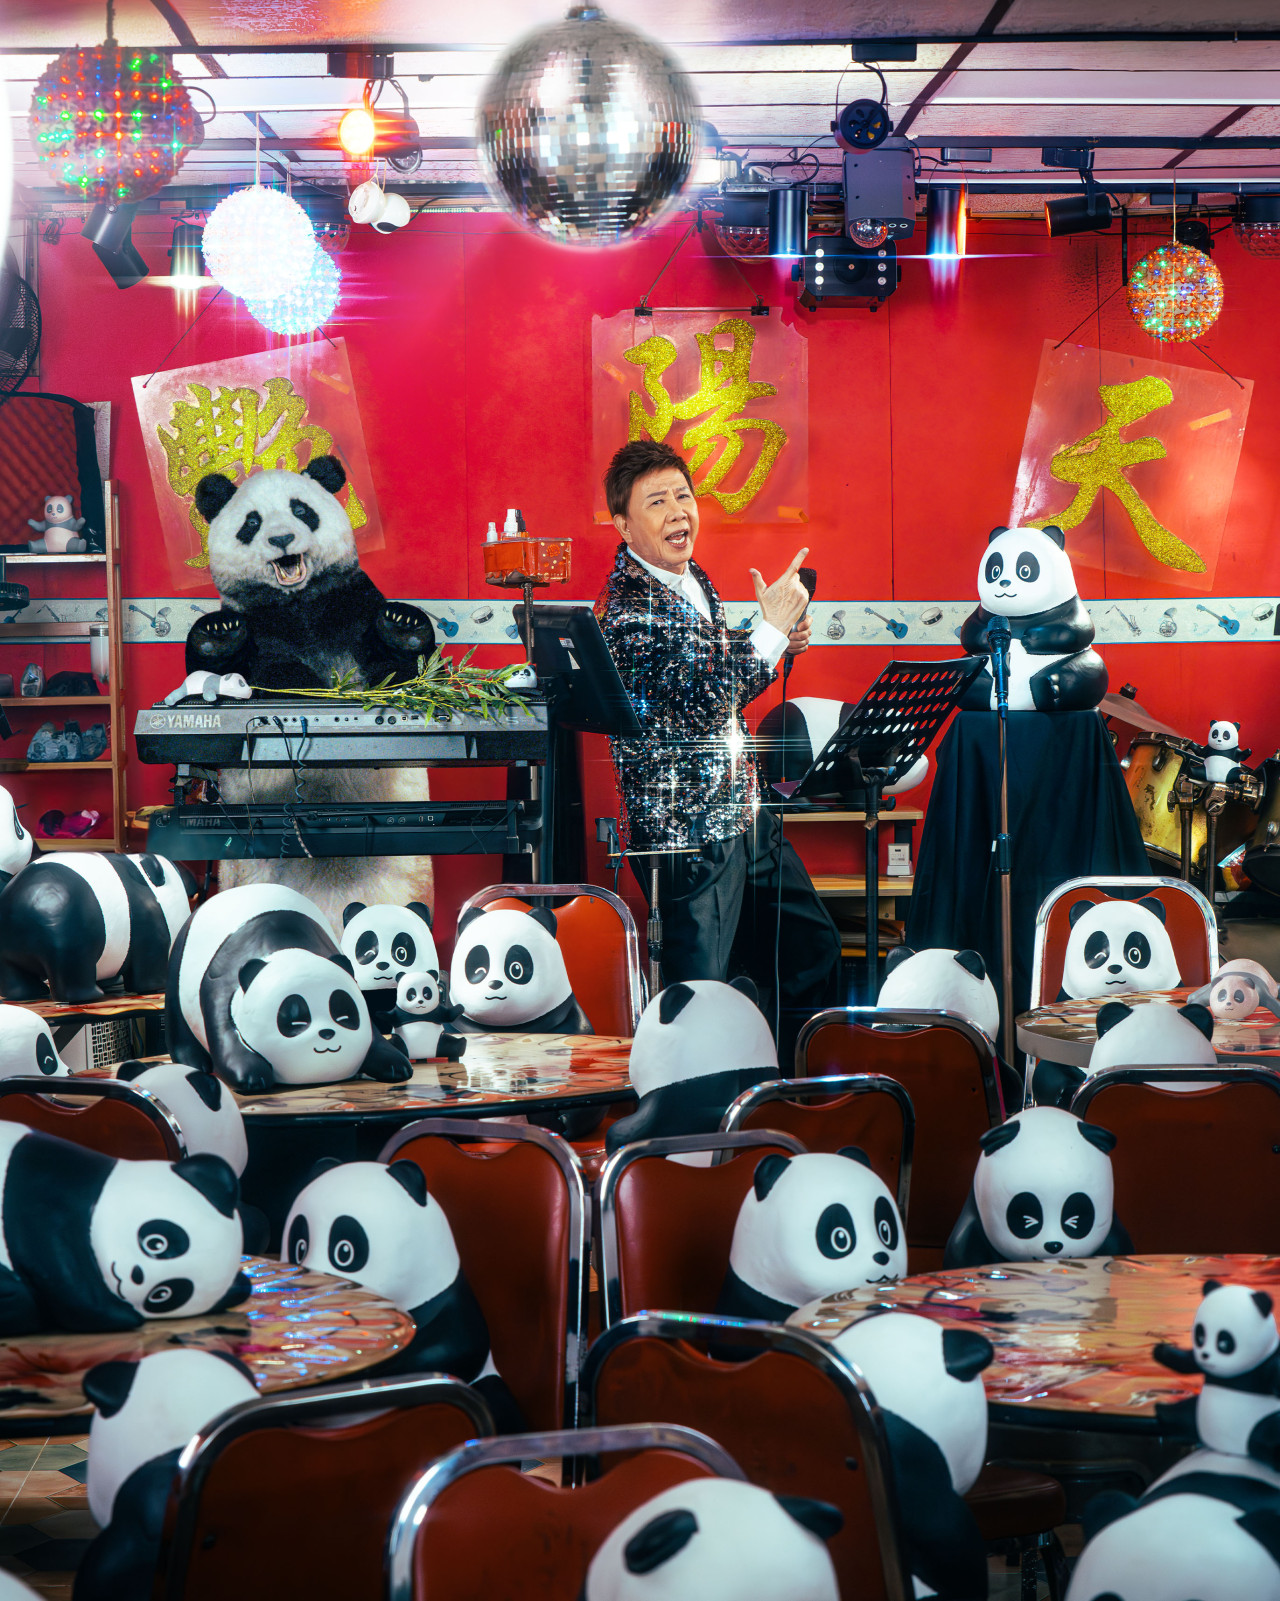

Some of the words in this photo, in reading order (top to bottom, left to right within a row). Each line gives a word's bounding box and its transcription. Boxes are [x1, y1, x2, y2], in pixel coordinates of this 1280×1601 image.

[623, 318, 788, 515] 陽
[1025, 375, 1207, 574] 天
[167, 714, 222, 728] YAMAHA
[179, 818, 221, 828] MAHA
